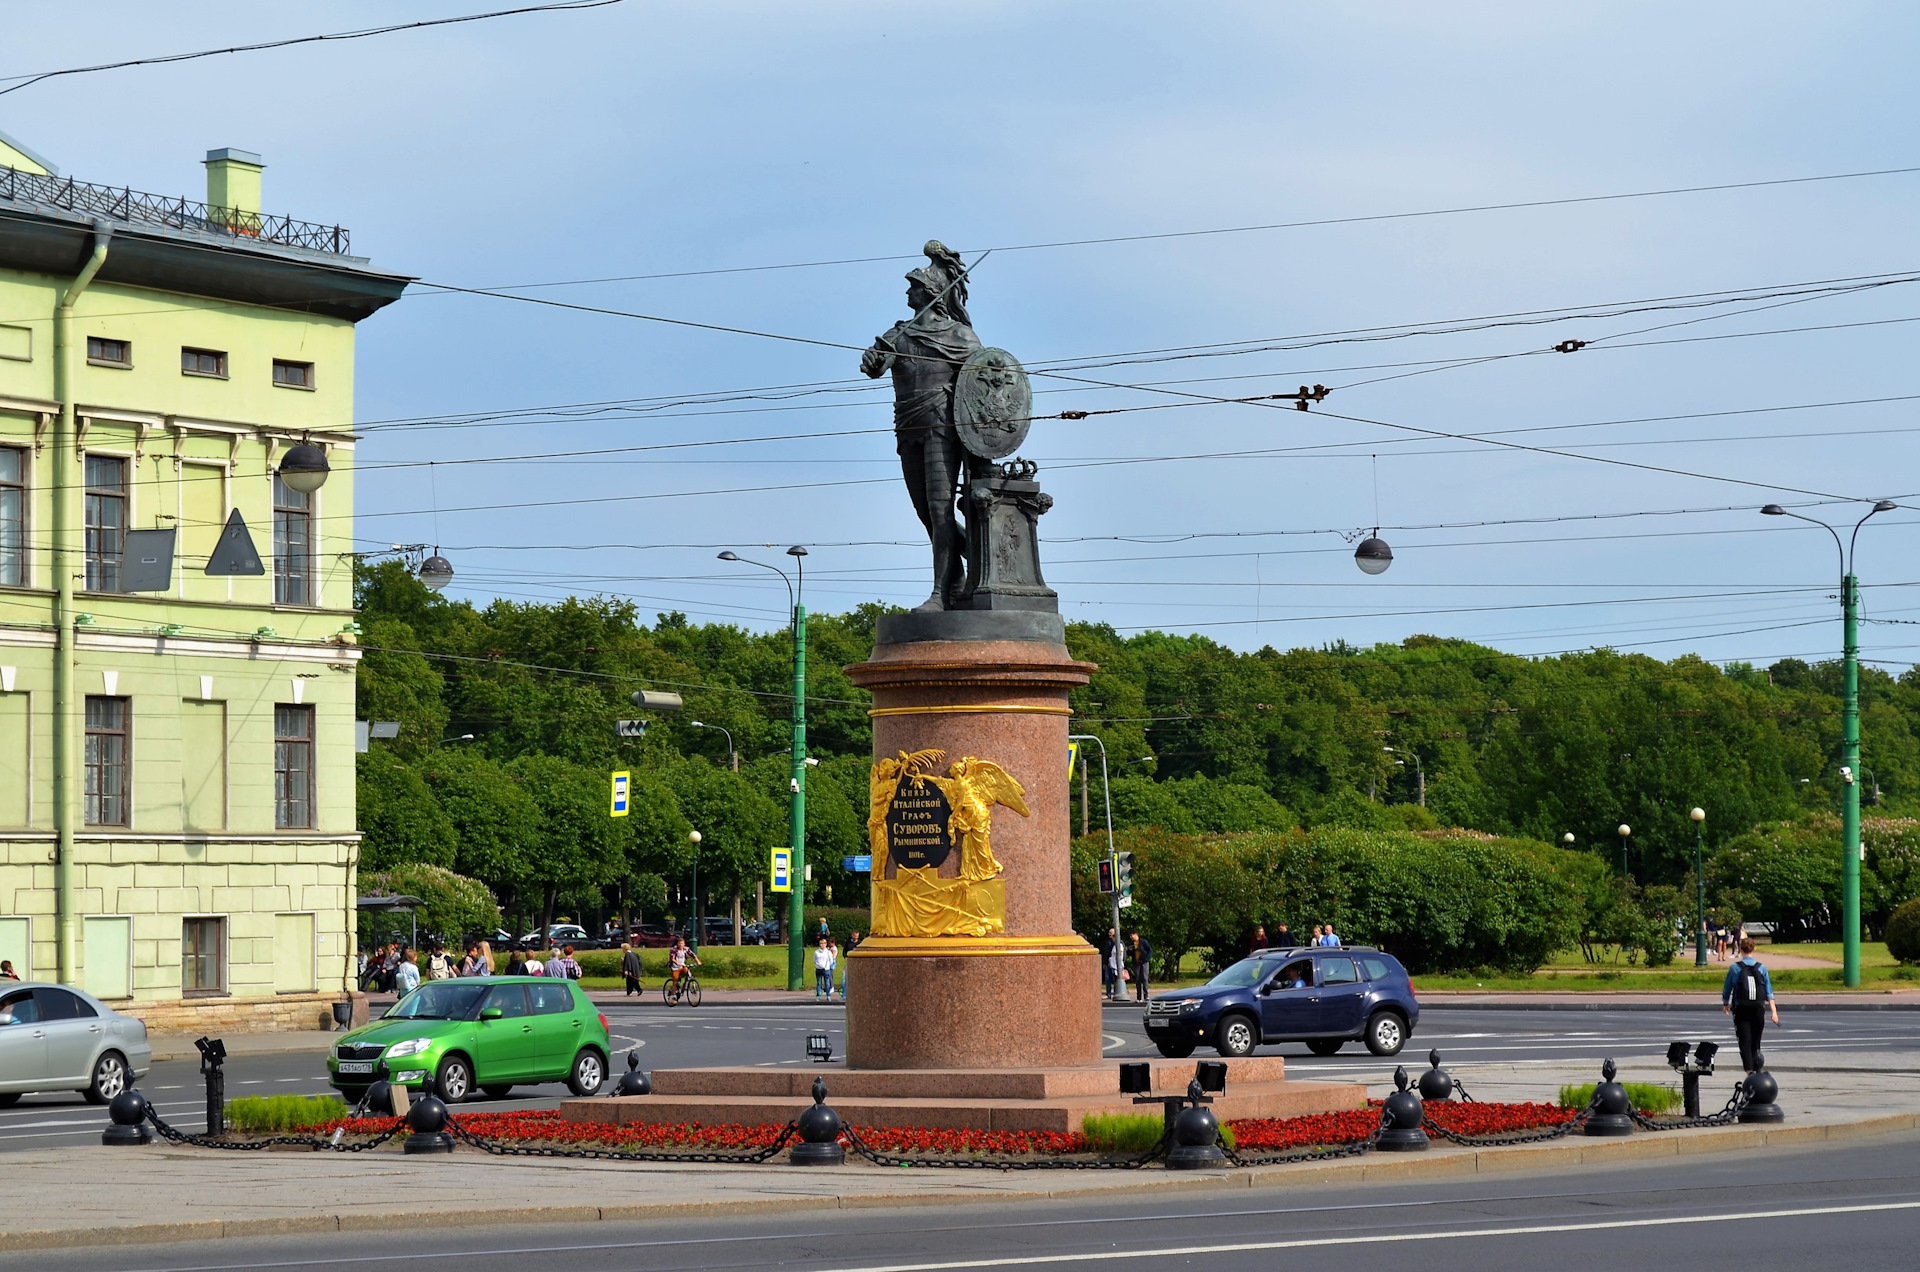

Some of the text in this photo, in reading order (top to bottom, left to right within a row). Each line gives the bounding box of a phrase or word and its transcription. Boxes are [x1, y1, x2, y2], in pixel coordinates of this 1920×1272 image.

[901, 788, 931, 797] Князь
[902, 811, 932, 820] Графъ
[893, 823, 942, 835] Суворовъ
